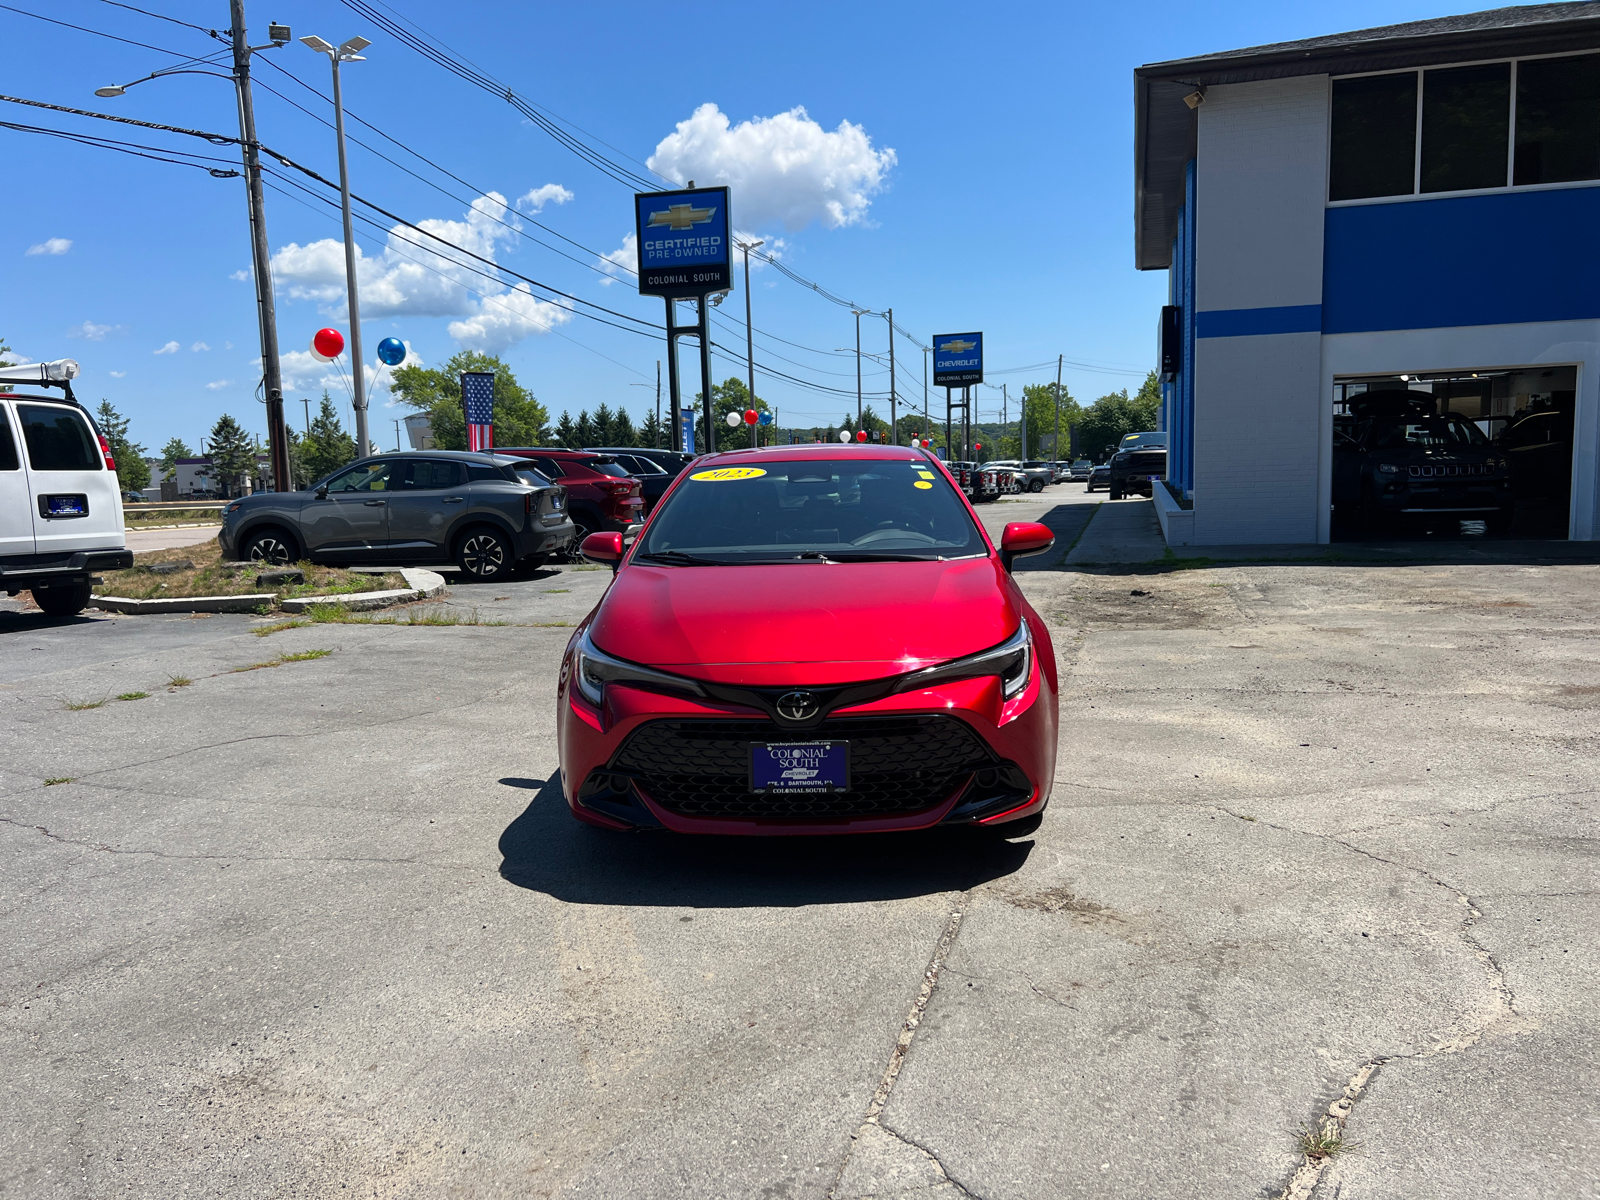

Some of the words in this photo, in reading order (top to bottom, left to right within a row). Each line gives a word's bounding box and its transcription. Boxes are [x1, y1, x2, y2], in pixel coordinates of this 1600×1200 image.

[644, 236, 721, 250] CERTIFIED
[648, 246, 718, 259] PRE-OWNED
[648, 274, 689, 285] COLONIAL
[693, 272, 720, 281] SOUTH
[937, 359, 978, 367] CHEVROLET
[770, 749, 828, 759] COLONIAL
[779, 758, 819, 768] SOUTH
